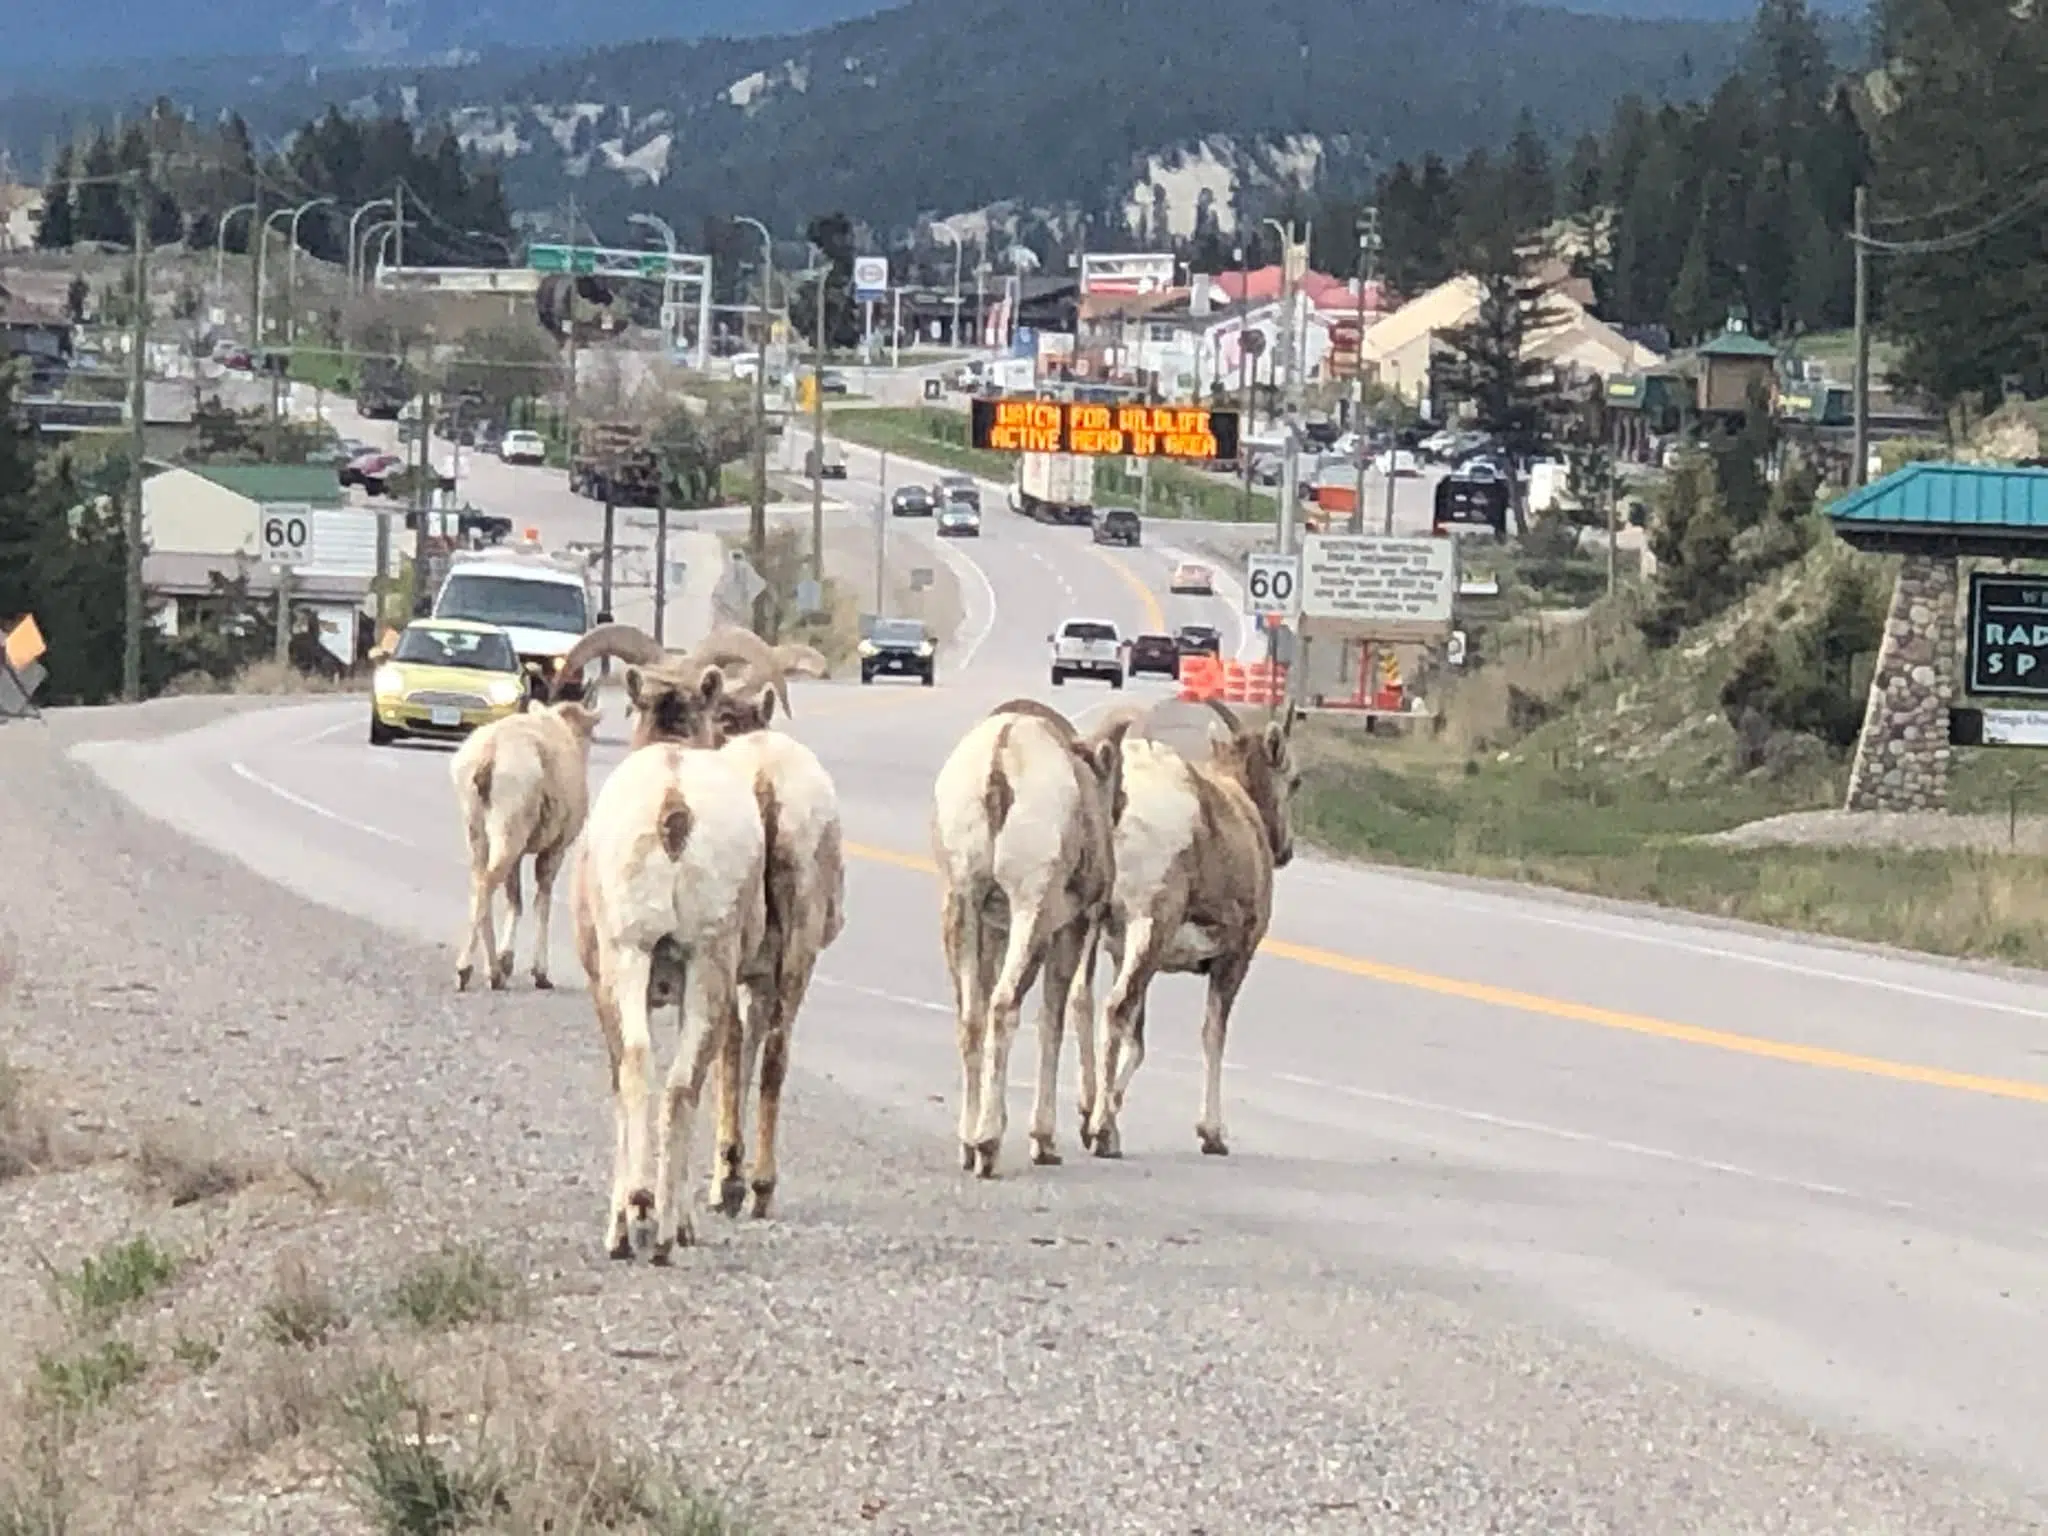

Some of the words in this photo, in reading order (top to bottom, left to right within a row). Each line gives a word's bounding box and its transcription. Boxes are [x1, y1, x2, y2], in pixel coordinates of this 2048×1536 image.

[996, 403, 1061, 430] WATCH
[1071, 406, 1111, 430] FOR
[1119, 409, 1212, 433] WILDLIFE
[990, 426, 1061, 450] ACTIVE
[1071, 430, 1123, 453] HERD
[1133, 432, 1155, 454] IN
[1164, 433, 1217, 457] AREA
[265, 518, 306, 547] 60
[1250, 569, 1292, 599] 60
